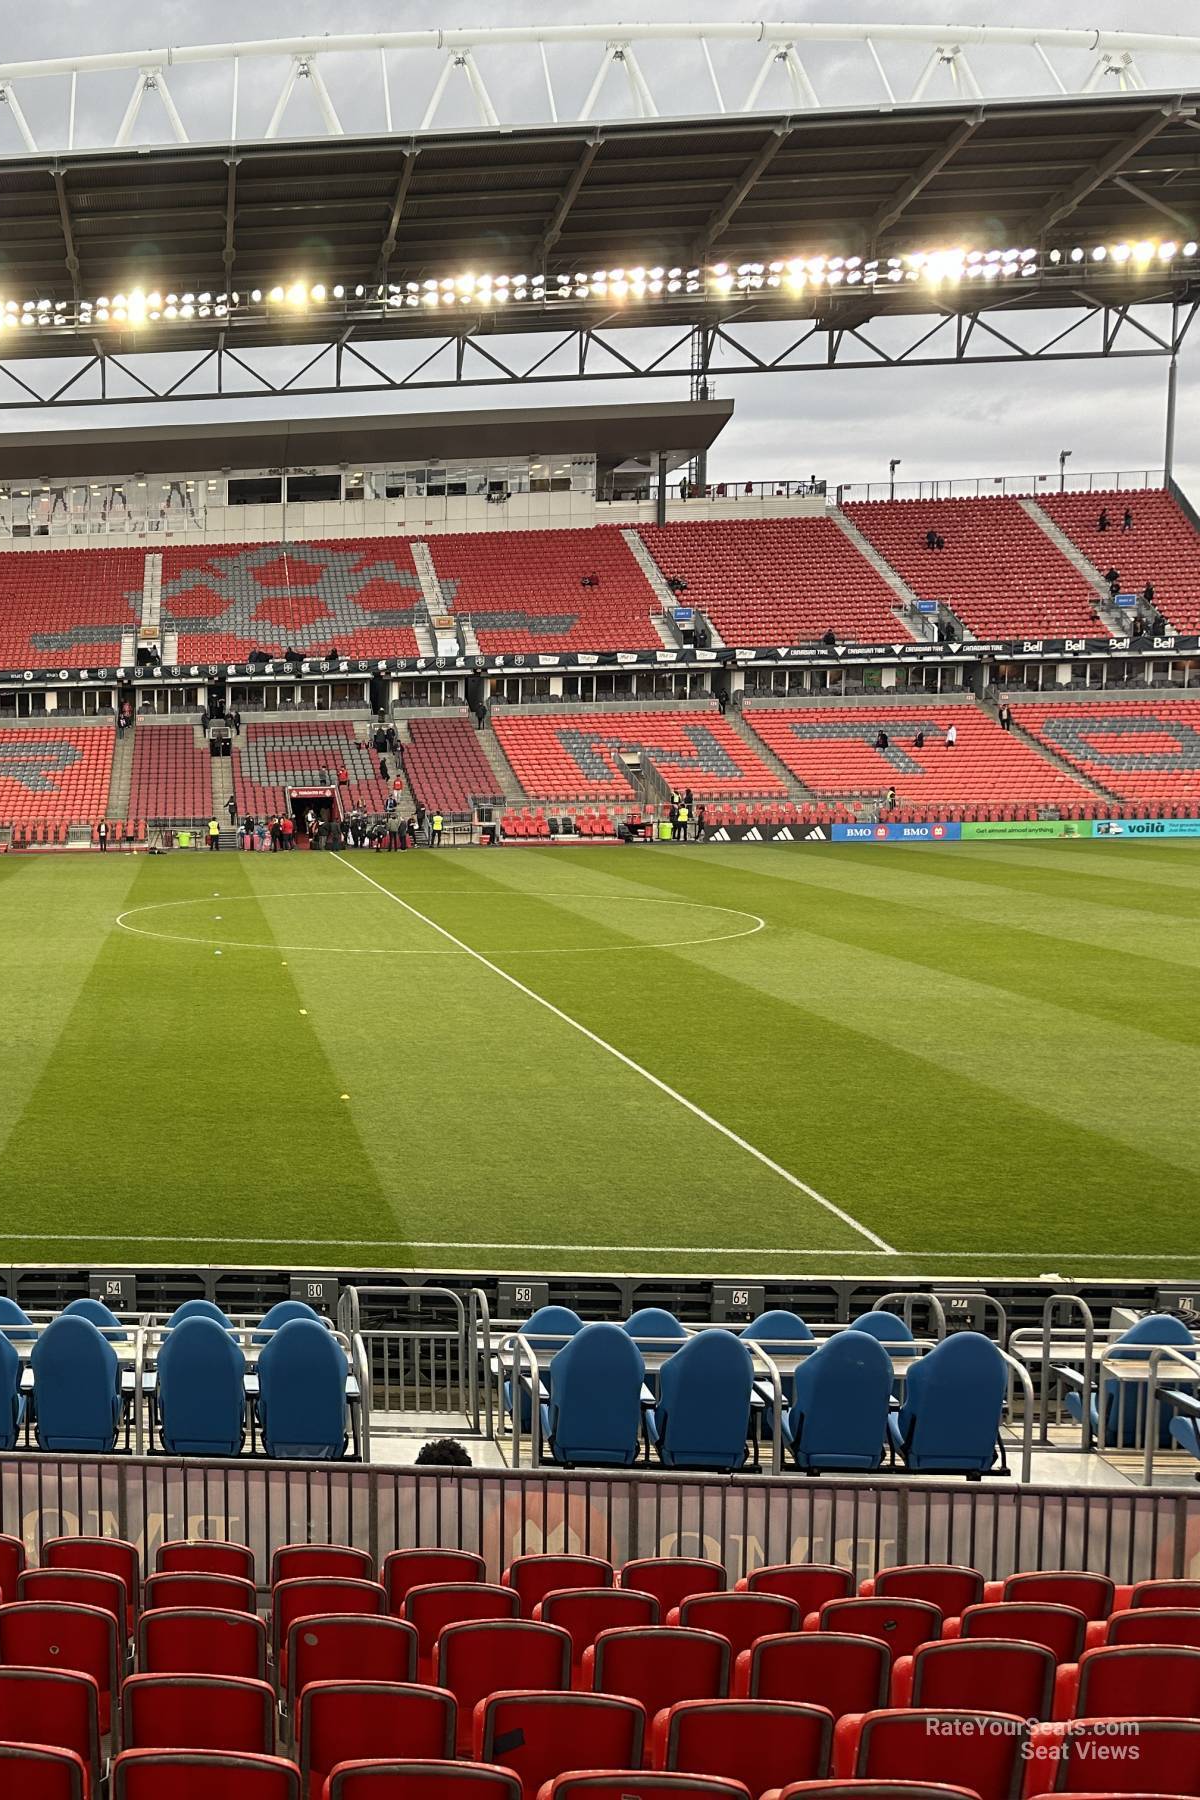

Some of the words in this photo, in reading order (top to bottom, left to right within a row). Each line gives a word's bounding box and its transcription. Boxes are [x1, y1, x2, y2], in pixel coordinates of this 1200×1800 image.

[1023, 641, 1043, 652] Bell
[1065, 640, 1085, 651] Bell
[1109, 638, 1130, 649] Bell
[1154, 637, 1174, 648] Bell
[846, 828, 871, 836] BMO
[903, 828, 928, 836] BMO
[1128, 822, 1164, 832] voilà
[105, 1281, 119, 1293] 54
[307, 1284, 321, 1297] 80
[516, 1288, 530, 1301] 58
[733, 1291, 747, 1304] 65
